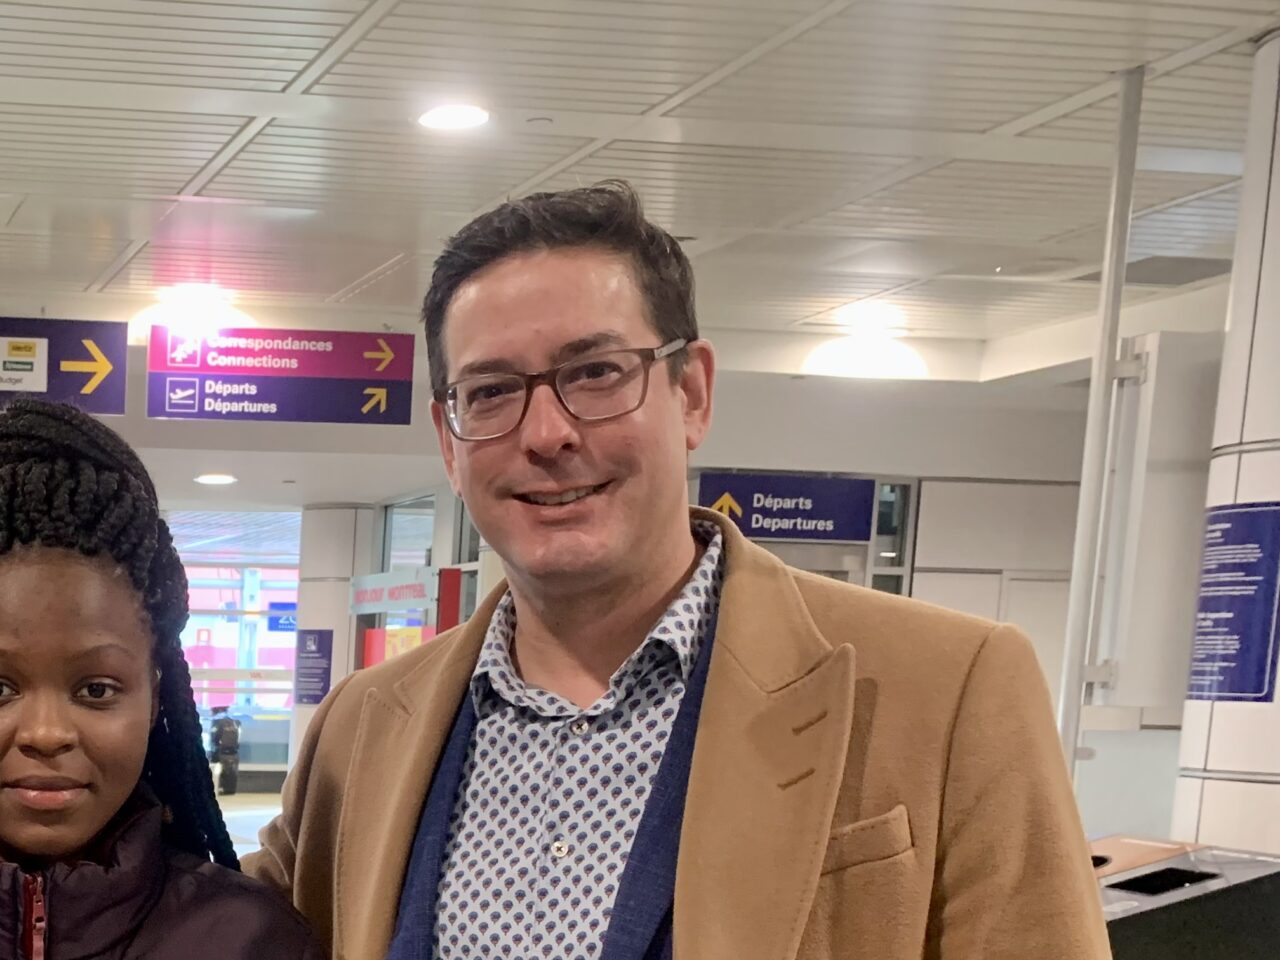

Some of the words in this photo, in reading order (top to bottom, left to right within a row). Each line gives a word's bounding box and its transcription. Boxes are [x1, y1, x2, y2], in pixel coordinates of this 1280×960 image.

[207, 336, 333, 352] Correspondances
[206, 351, 298, 369] Connections
[205, 380, 257, 397] Départs
[752, 493, 812, 512] Départs
[751, 513, 834, 532] Departures
